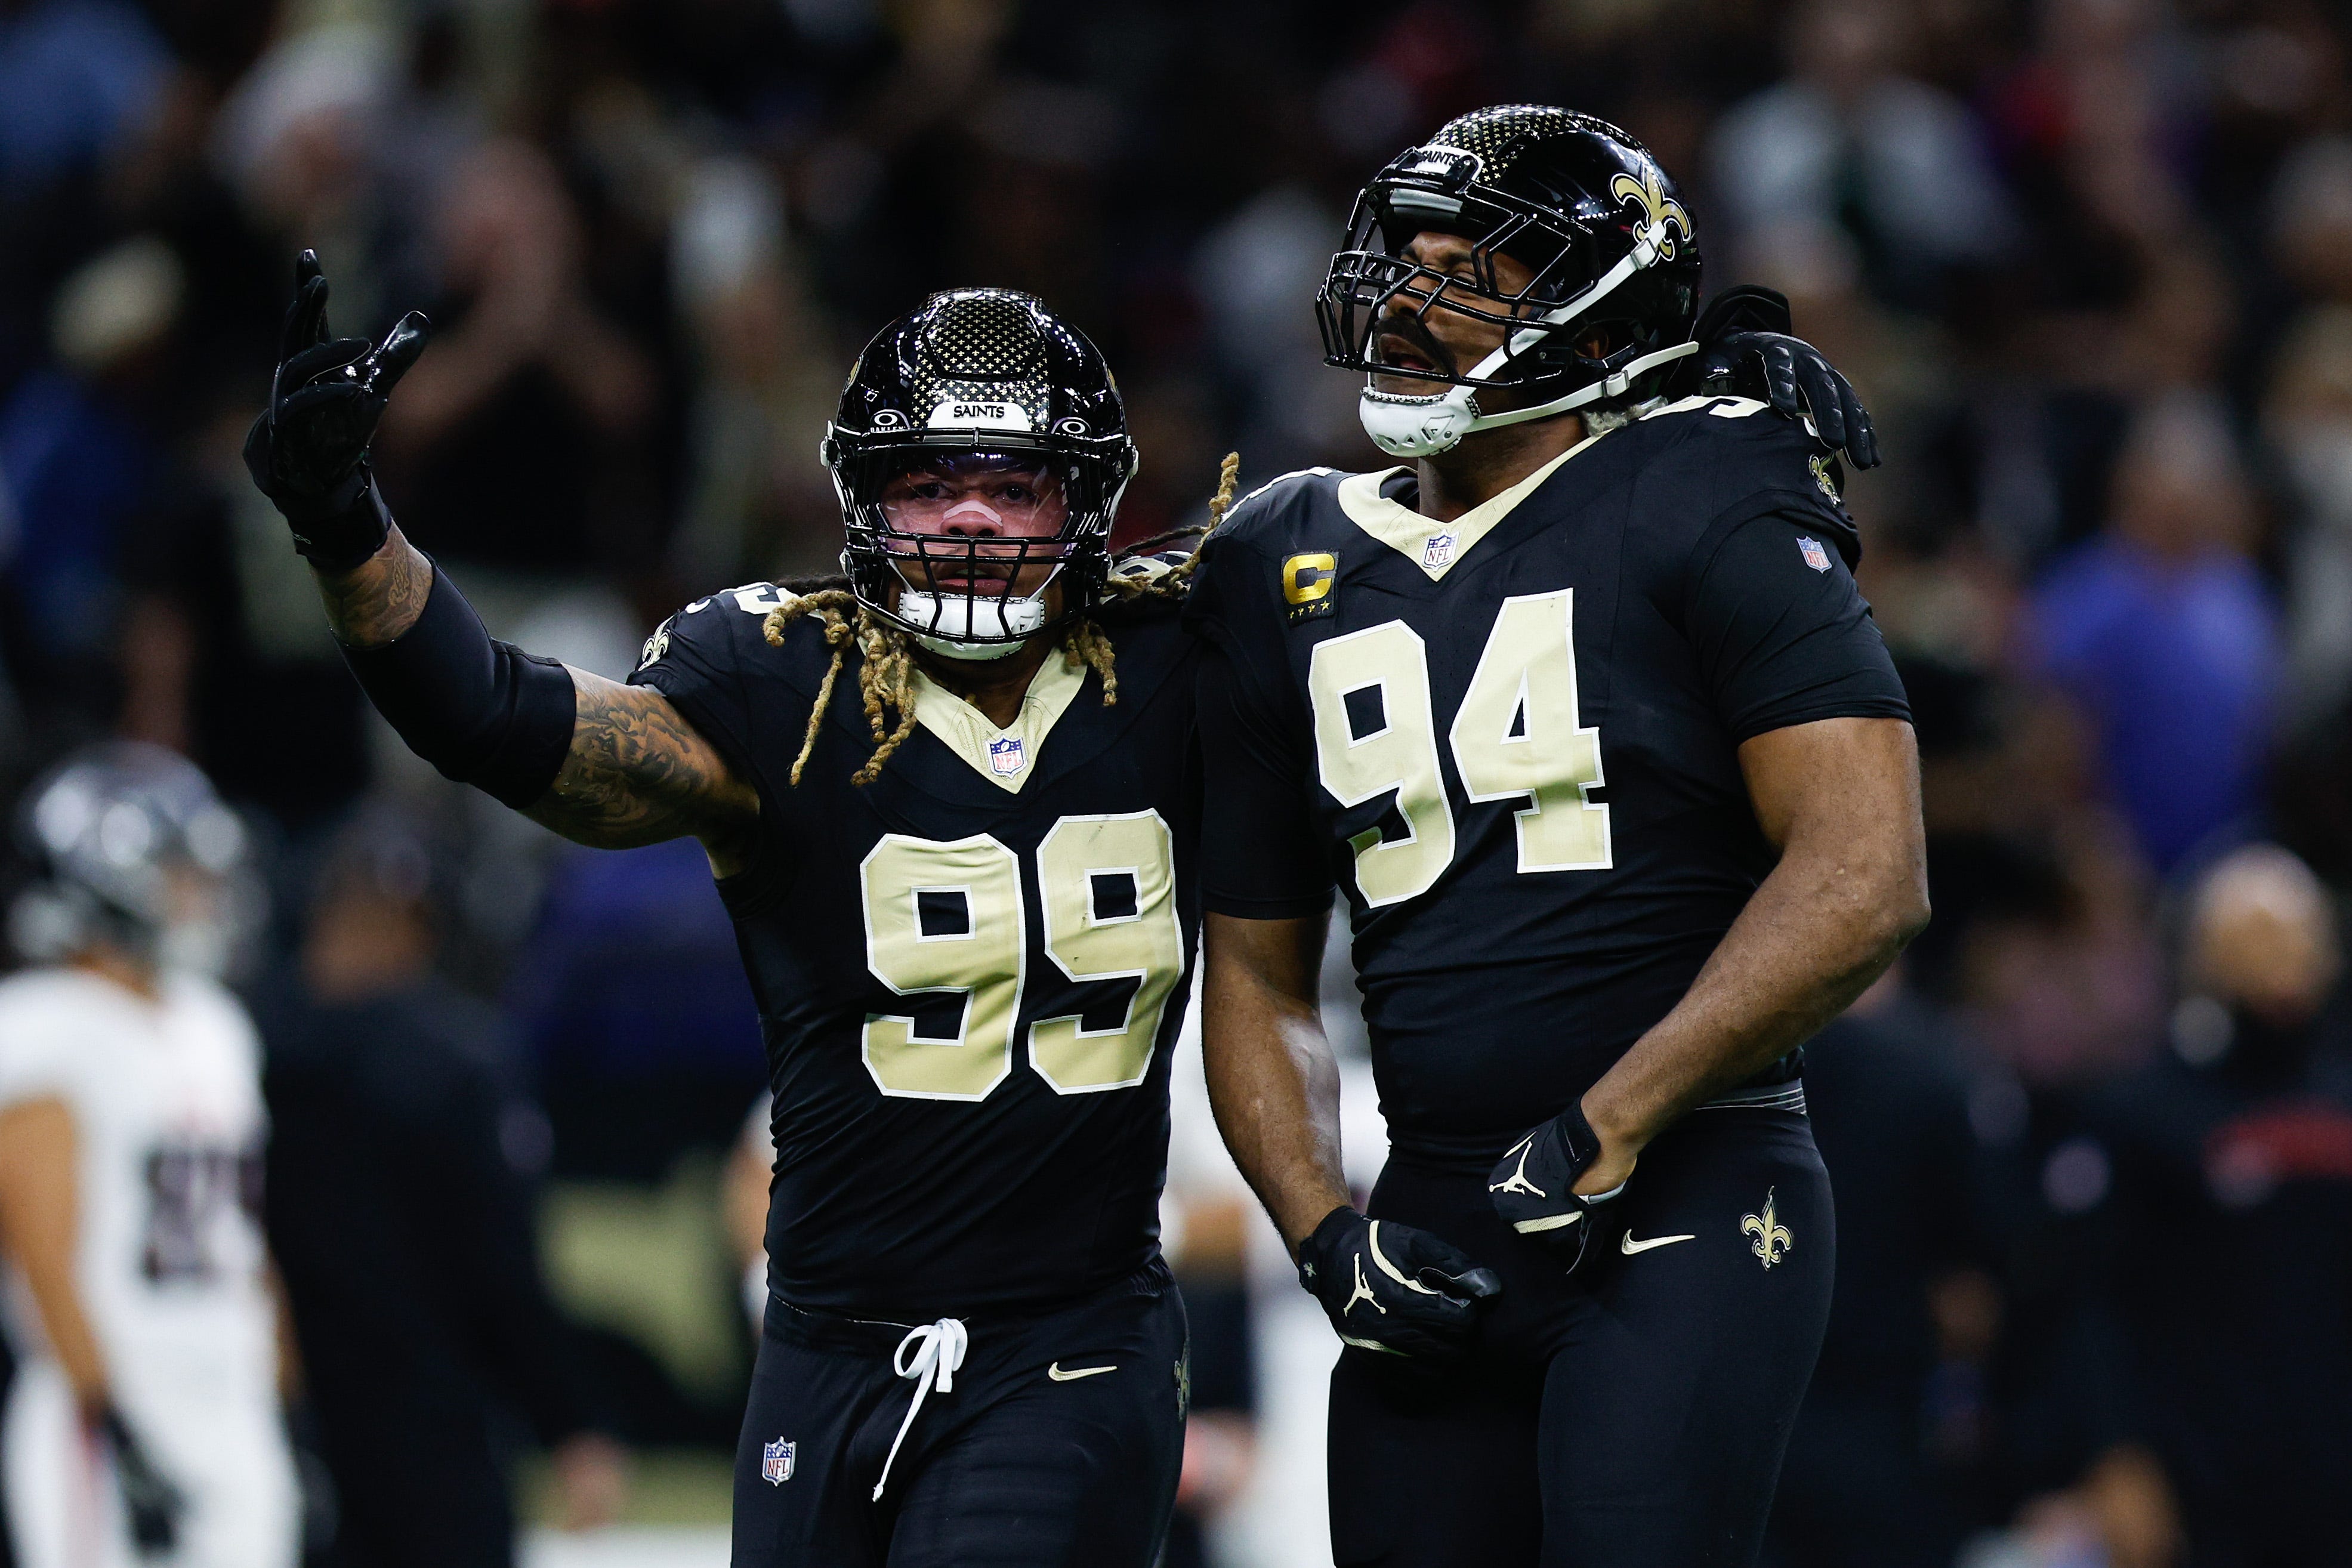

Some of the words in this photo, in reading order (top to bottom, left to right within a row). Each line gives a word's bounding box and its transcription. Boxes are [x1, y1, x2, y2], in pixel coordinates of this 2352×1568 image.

[953, 405, 1005, 418] SAINTS
[1427, 548, 1449, 563] NFL
[1307, 587, 1613, 909] 94
[995, 752, 1022, 770] NFL
[860, 807, 1185, 1103] 99
[767, 1459, 788, 1477] NFL
